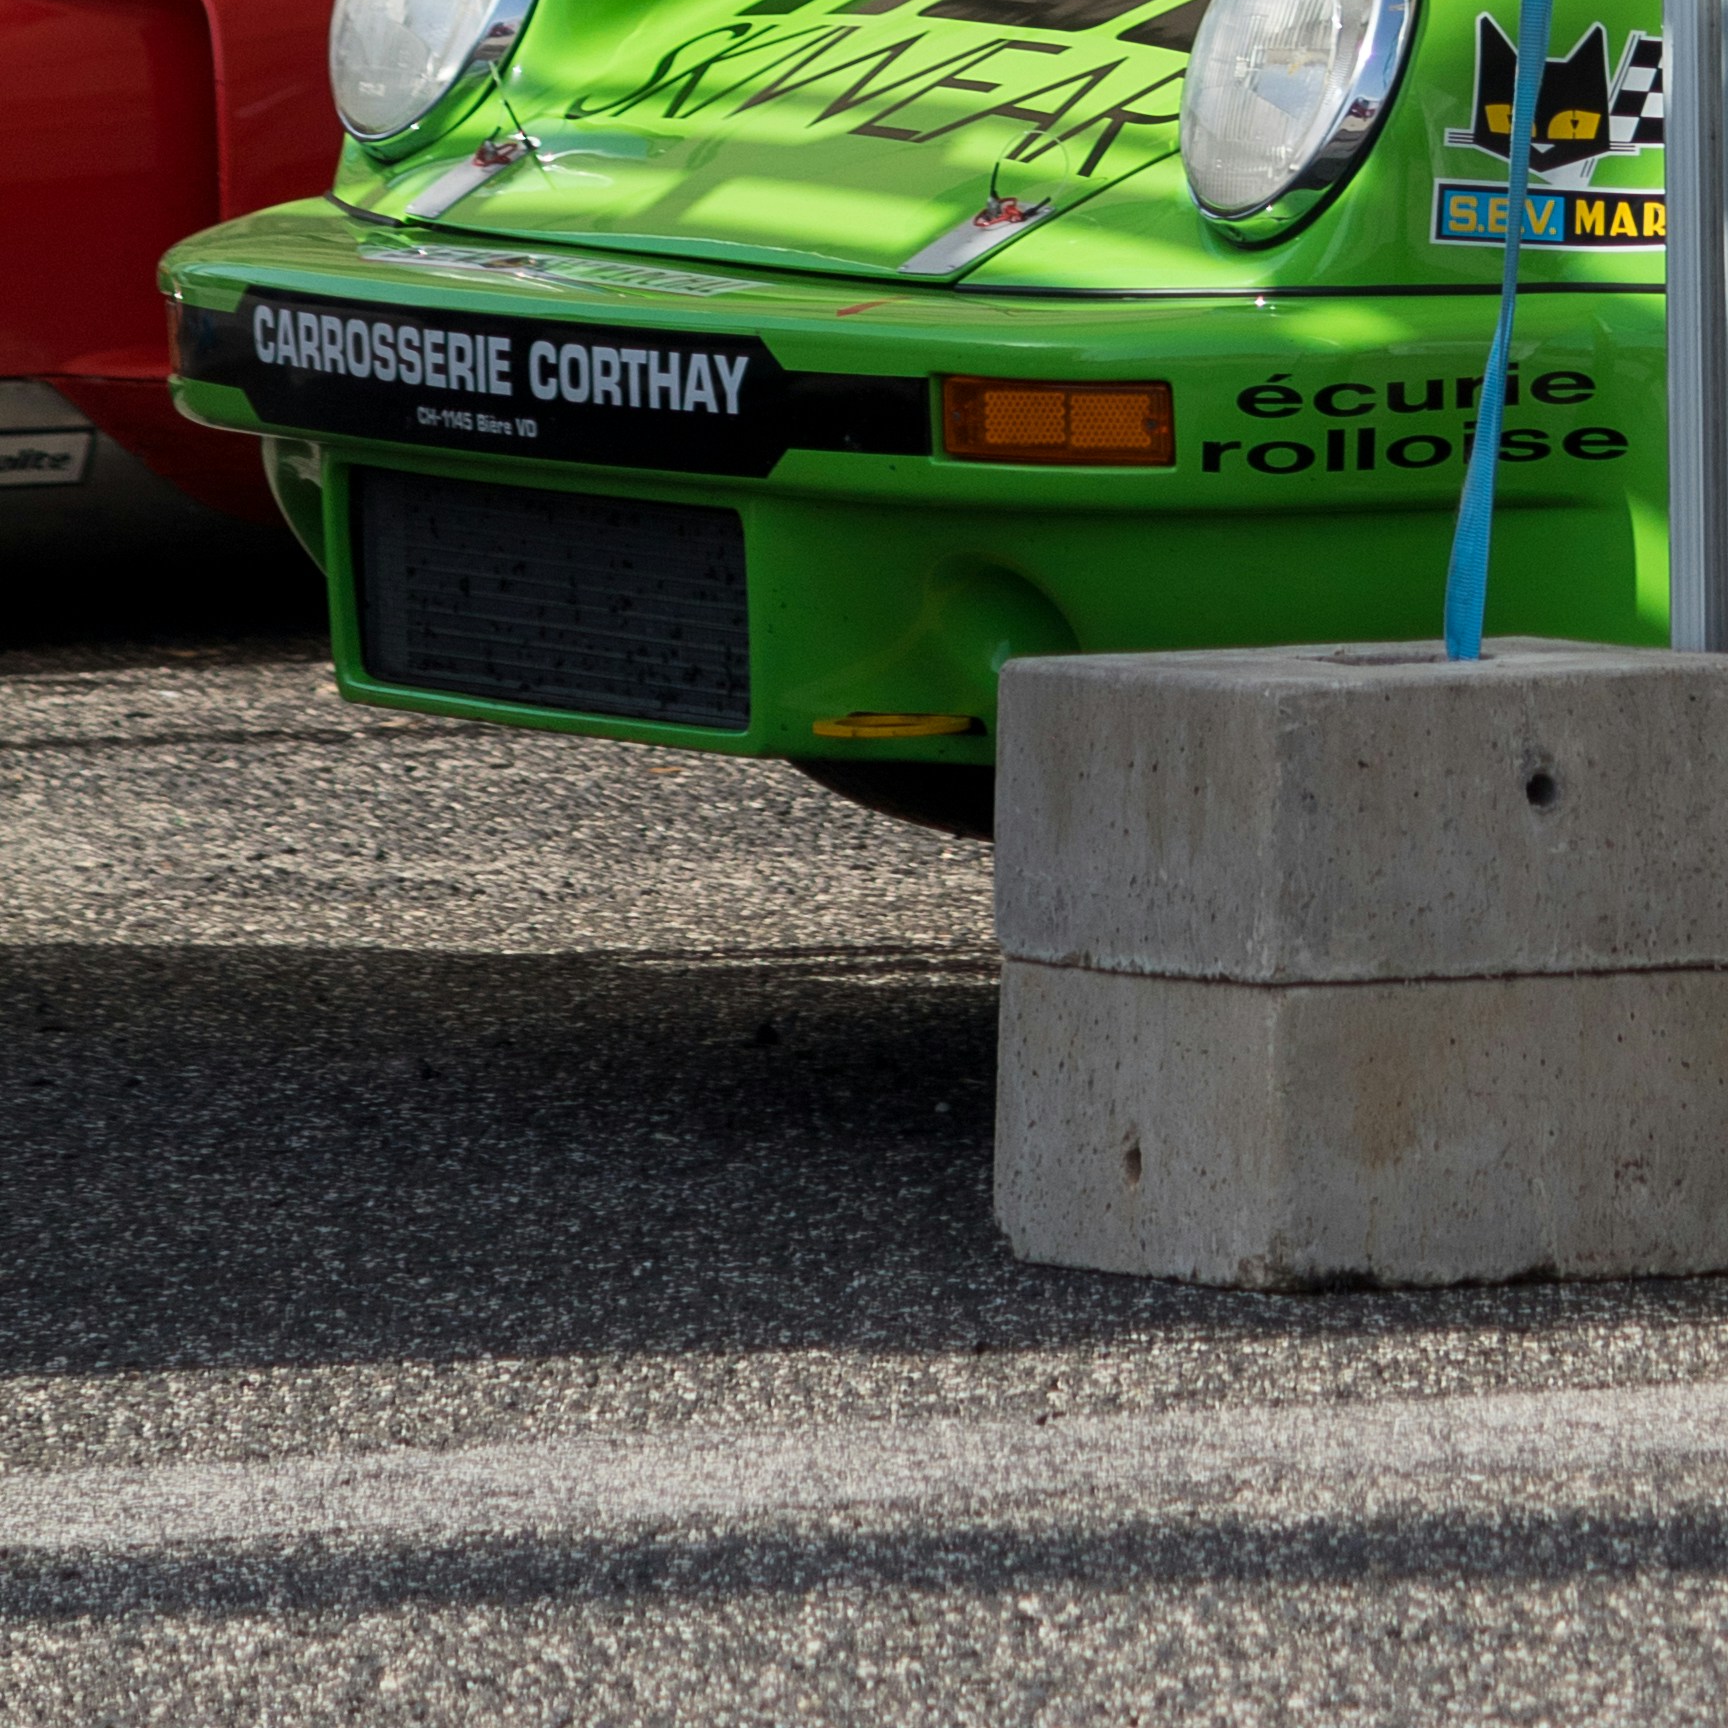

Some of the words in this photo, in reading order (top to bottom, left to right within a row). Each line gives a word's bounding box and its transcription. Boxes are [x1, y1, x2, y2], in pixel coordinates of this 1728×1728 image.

[252, 304, 513, 397] CARROSSERIE
[529, 340, 750, 415] CORTHAY
[416, 406, 473, 432] CH-1145
[516, 417, 538, 439] VD
